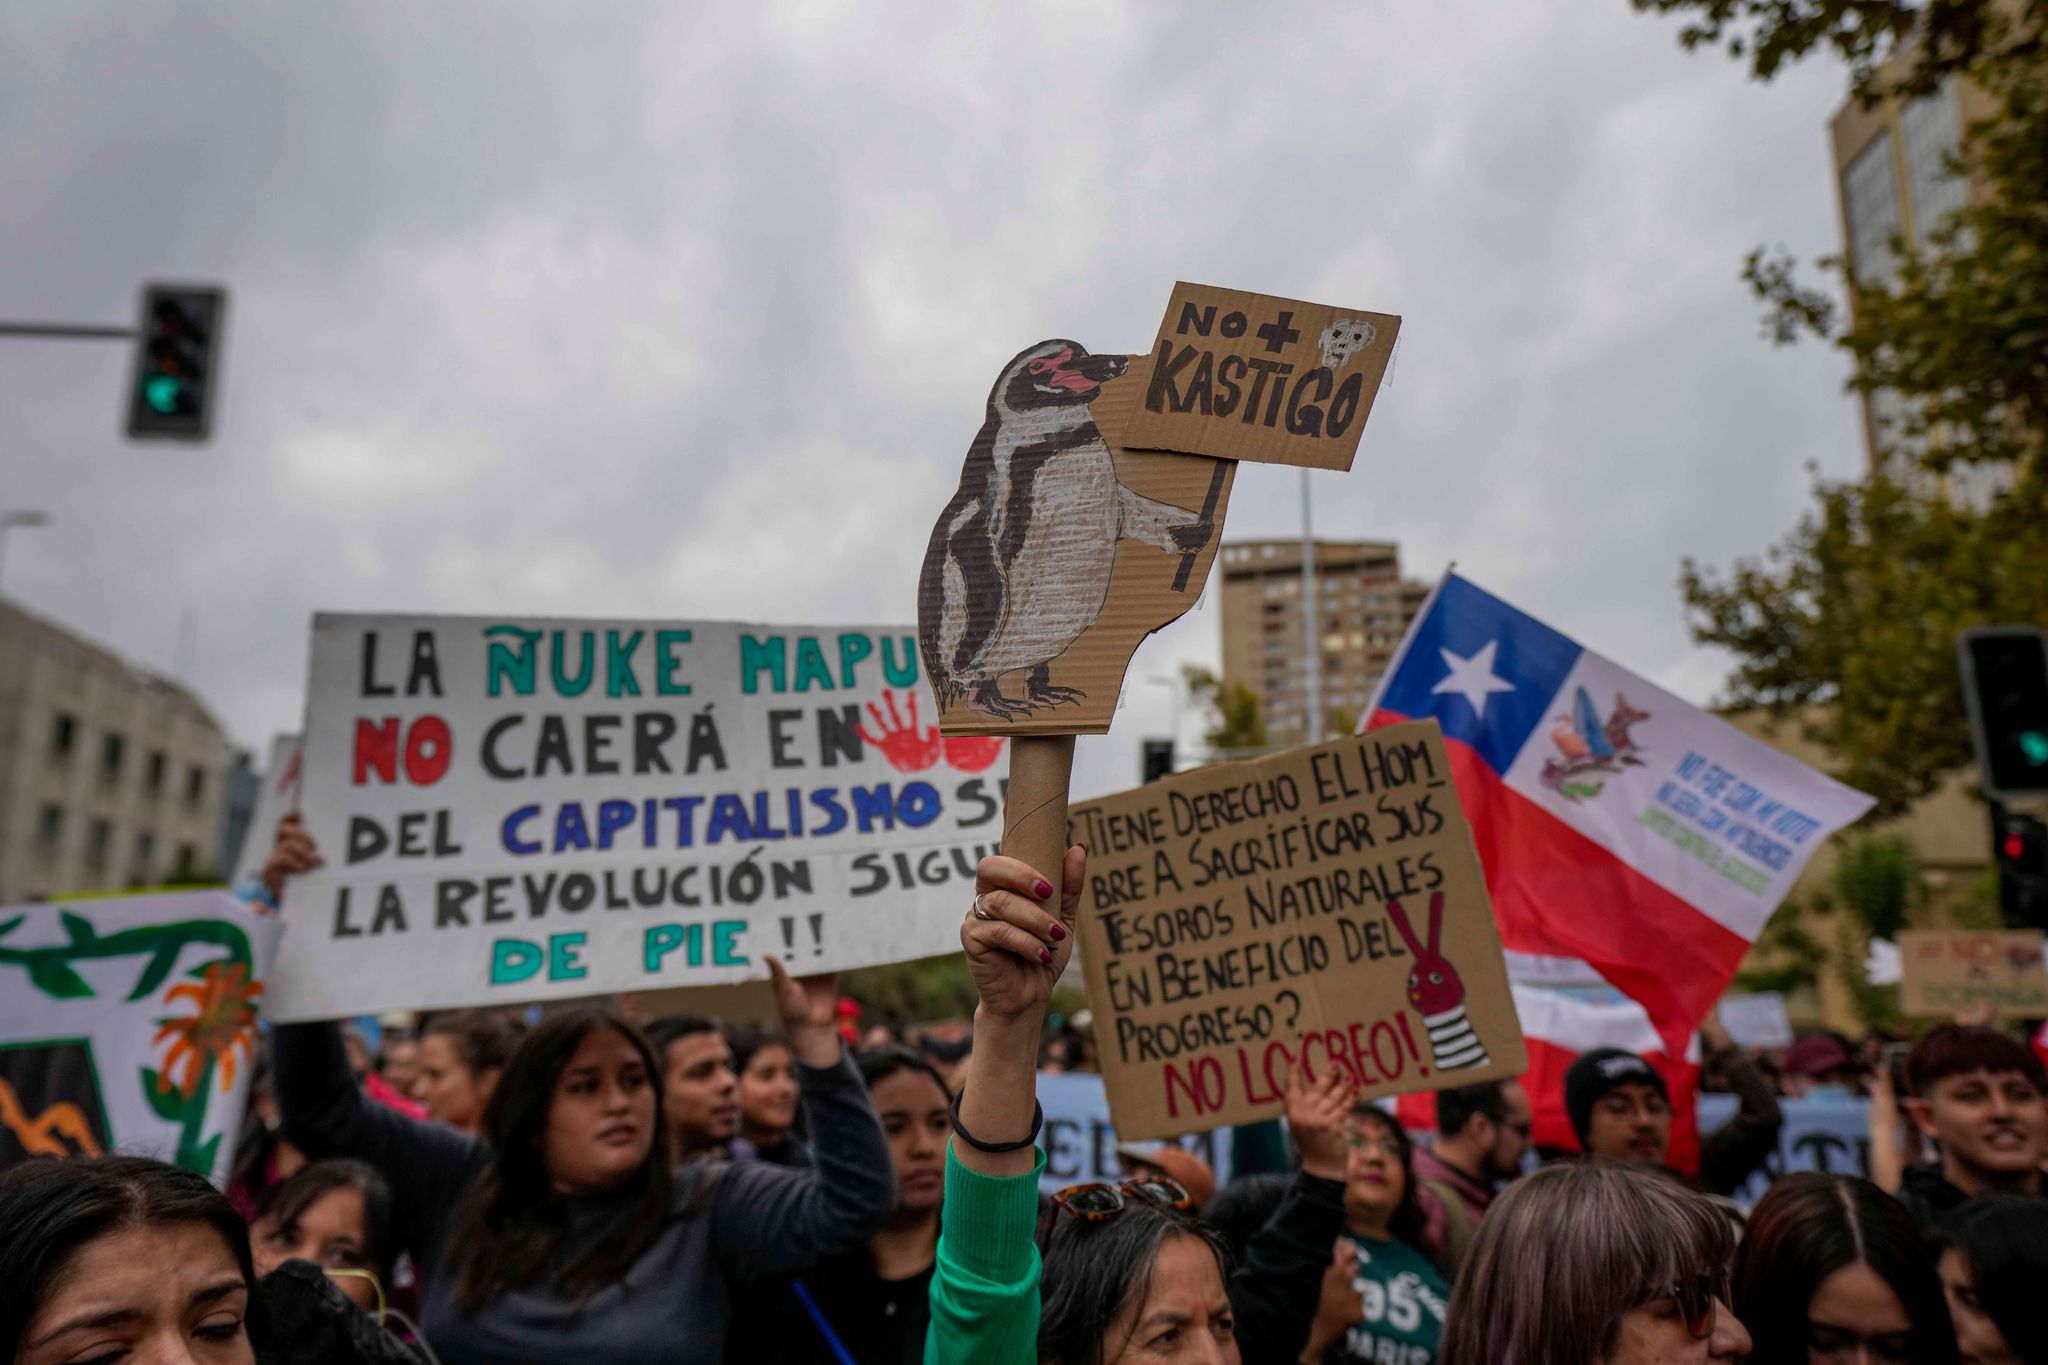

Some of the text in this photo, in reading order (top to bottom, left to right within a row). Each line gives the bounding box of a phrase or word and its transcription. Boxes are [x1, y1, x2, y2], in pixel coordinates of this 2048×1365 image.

[1176, 301, 1248, 338] NO
[1144, 339, 1363, 439] KASTiGO
[361, 624, 919, 698] LA ÑUKE MAPU
[351, 703, 865, 787] NO CAERÁ EN
[345, 809, 462, 867] DEL
[500, 780, 944, 857] CAPITALISMO
[1168, 772, 1299, 838] DERECHO
[1310, 751, 1361, 803] EL
[332, 842, 1000, 939] LA REVOLUCIÓN SIGU
[1091, 863, 1147, 910] BRE
[1153, 849, 1183, 896] A
[1377, 793, 1446, 844] SUS
[1096, 850, 1444, 955] TESOROS NATURALES
[489, 932, 588, 985] DE
[643, 920, 751, 973] PIE
[1104, 916, 1407, 1013] EN BENEFICIO DEL
[1163, 1054, 1226, 1119] NO
[1237, 1040, 1297, 1106] LO
